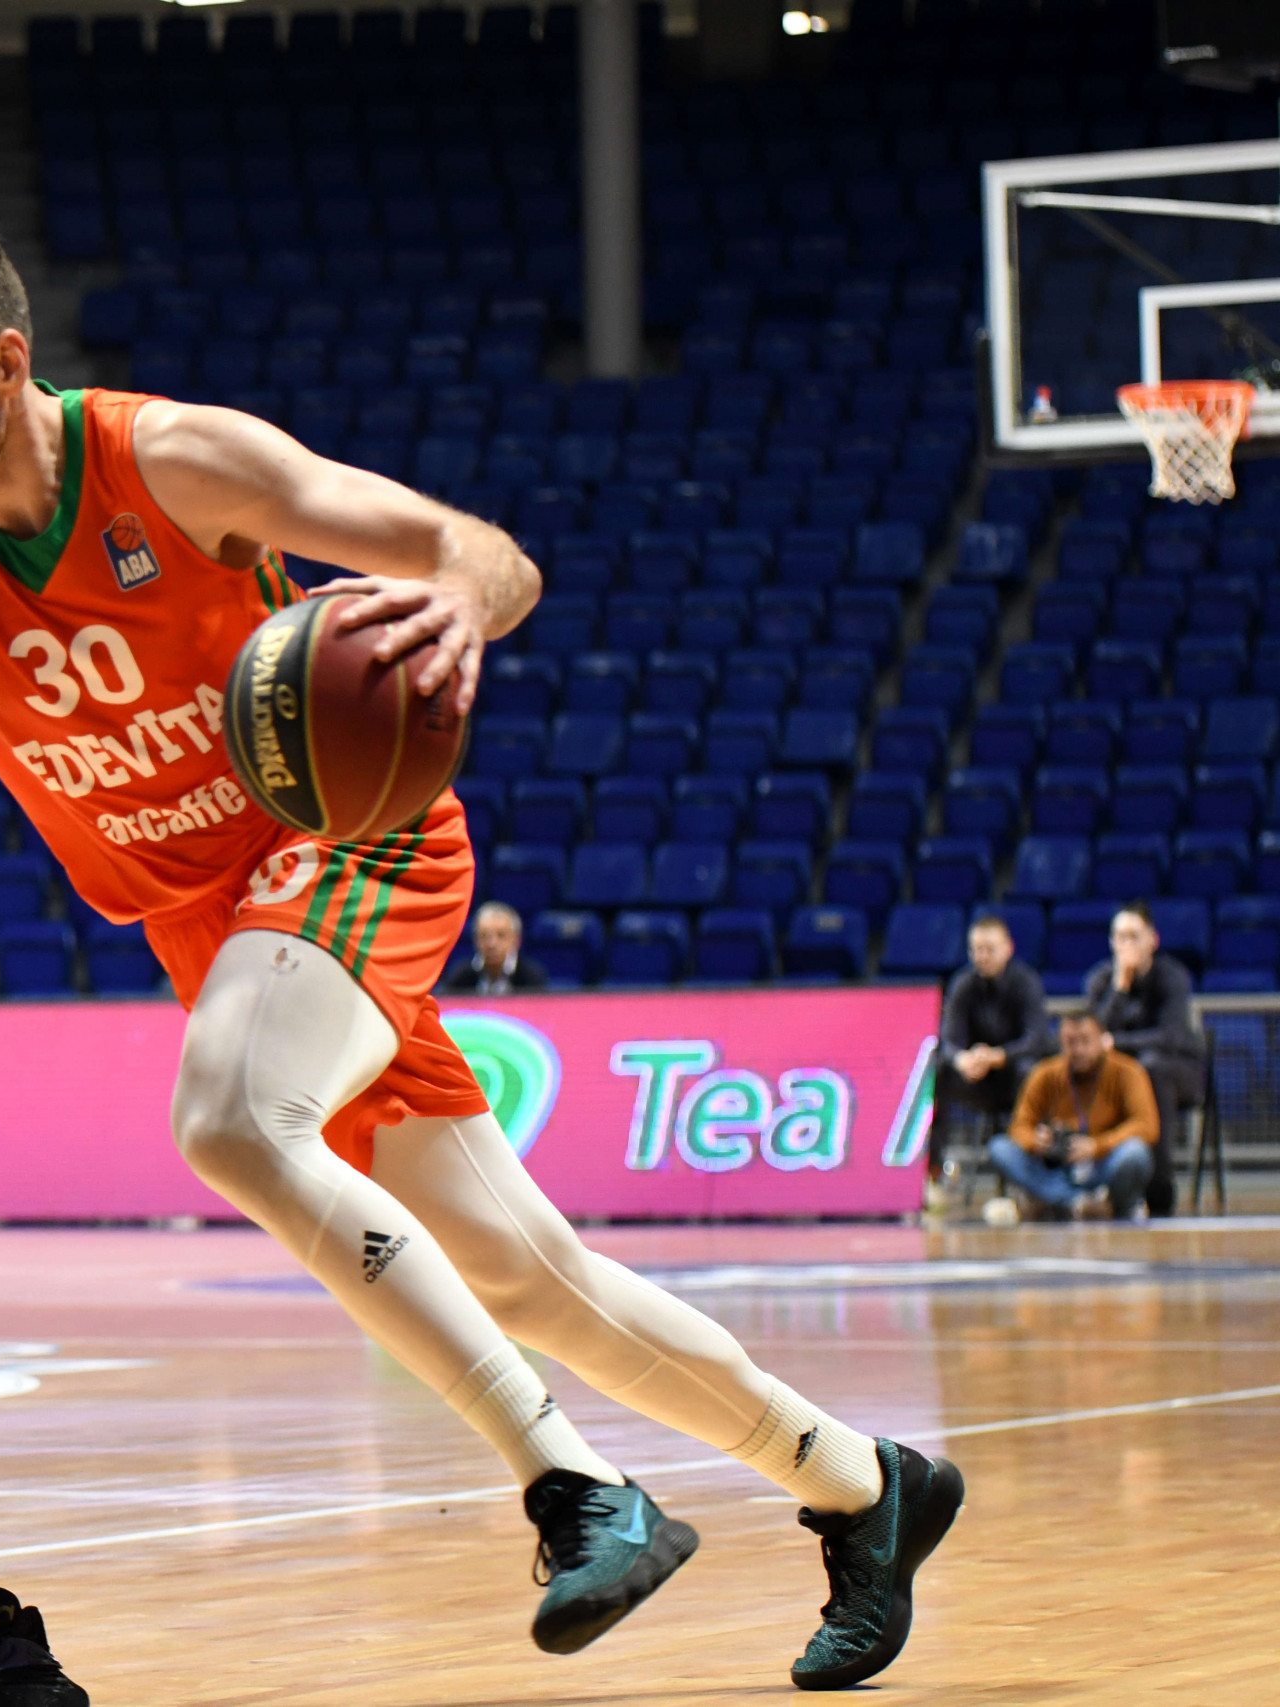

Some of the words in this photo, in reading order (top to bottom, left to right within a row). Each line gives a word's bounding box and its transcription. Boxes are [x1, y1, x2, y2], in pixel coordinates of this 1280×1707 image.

[118, 550, 156, 585] ABA
[7, 624, 146, 719] 30
[251, 625, 298, 793] SPALDING
[609, 1039, 850, 1173] Tea
[365, 1234, 410, 1283] adidas
